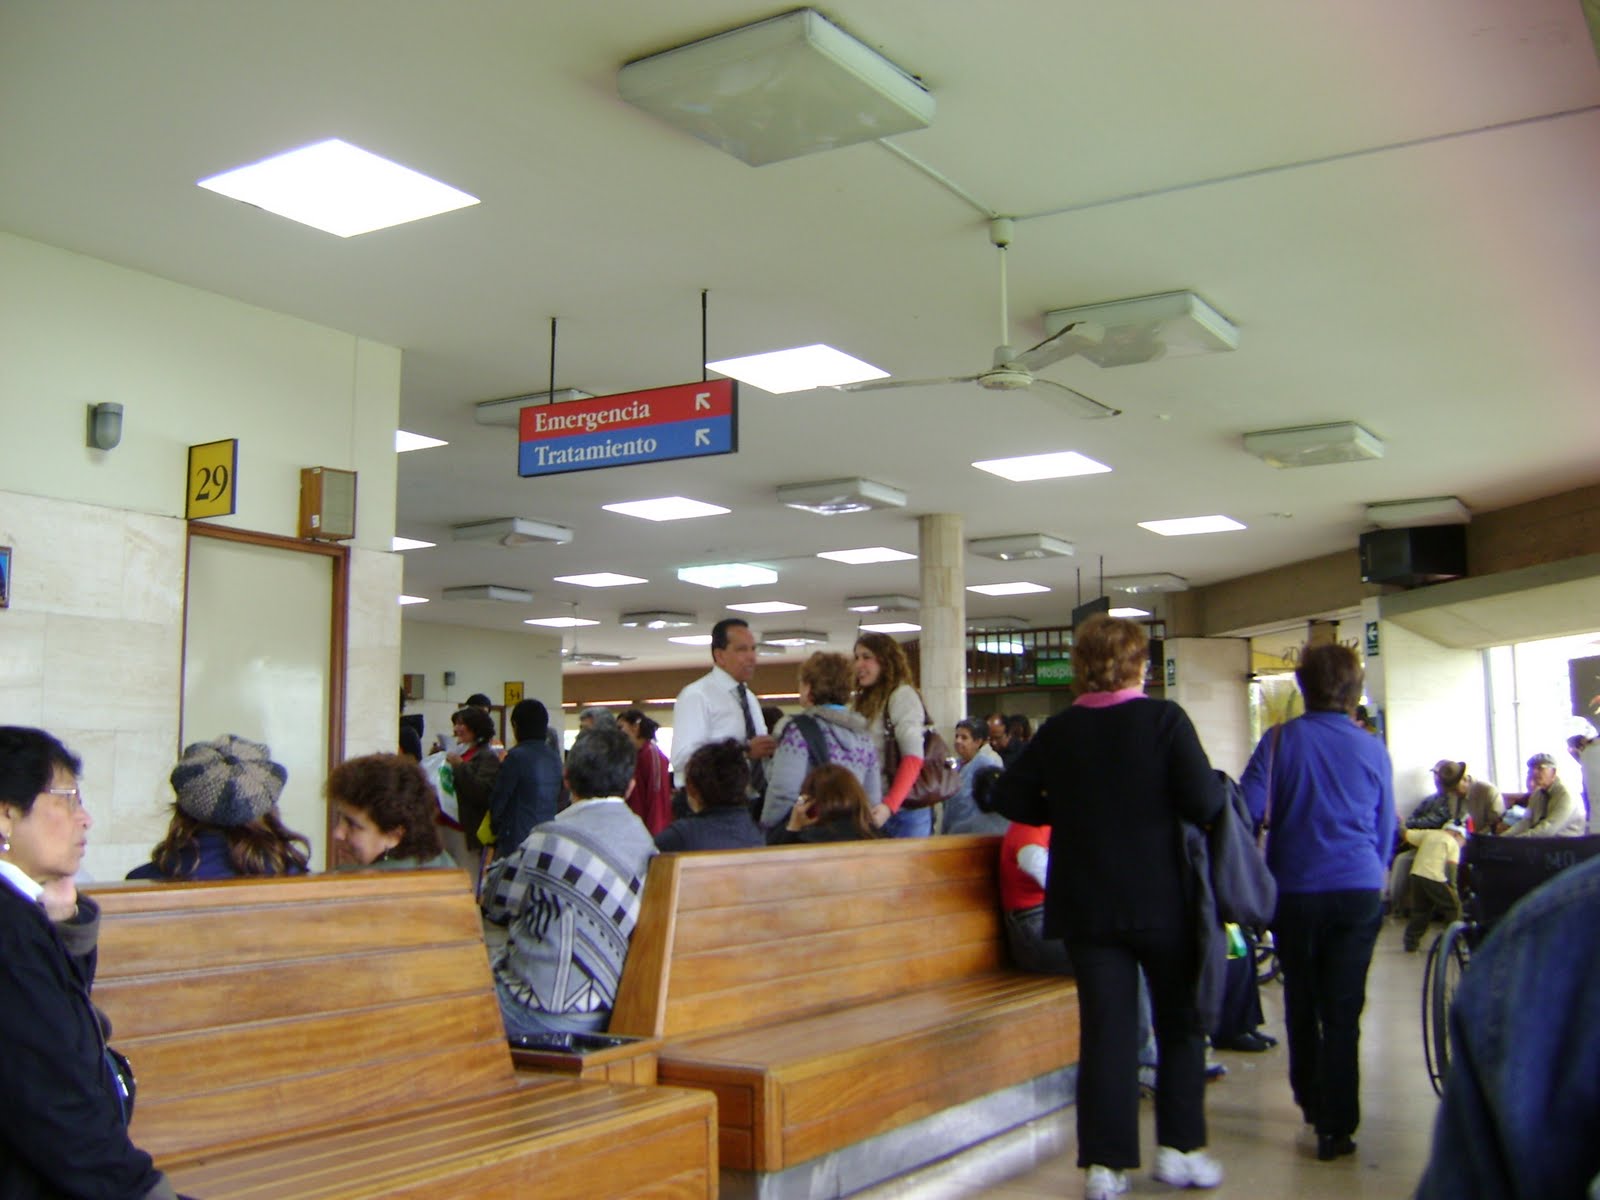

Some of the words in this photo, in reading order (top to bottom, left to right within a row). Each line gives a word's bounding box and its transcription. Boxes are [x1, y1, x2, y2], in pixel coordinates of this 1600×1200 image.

[534, 401, 651, 432] Emergencia
[534, 437, 657, 466] Tratamiento
[195, 464, 228, 503] 29
